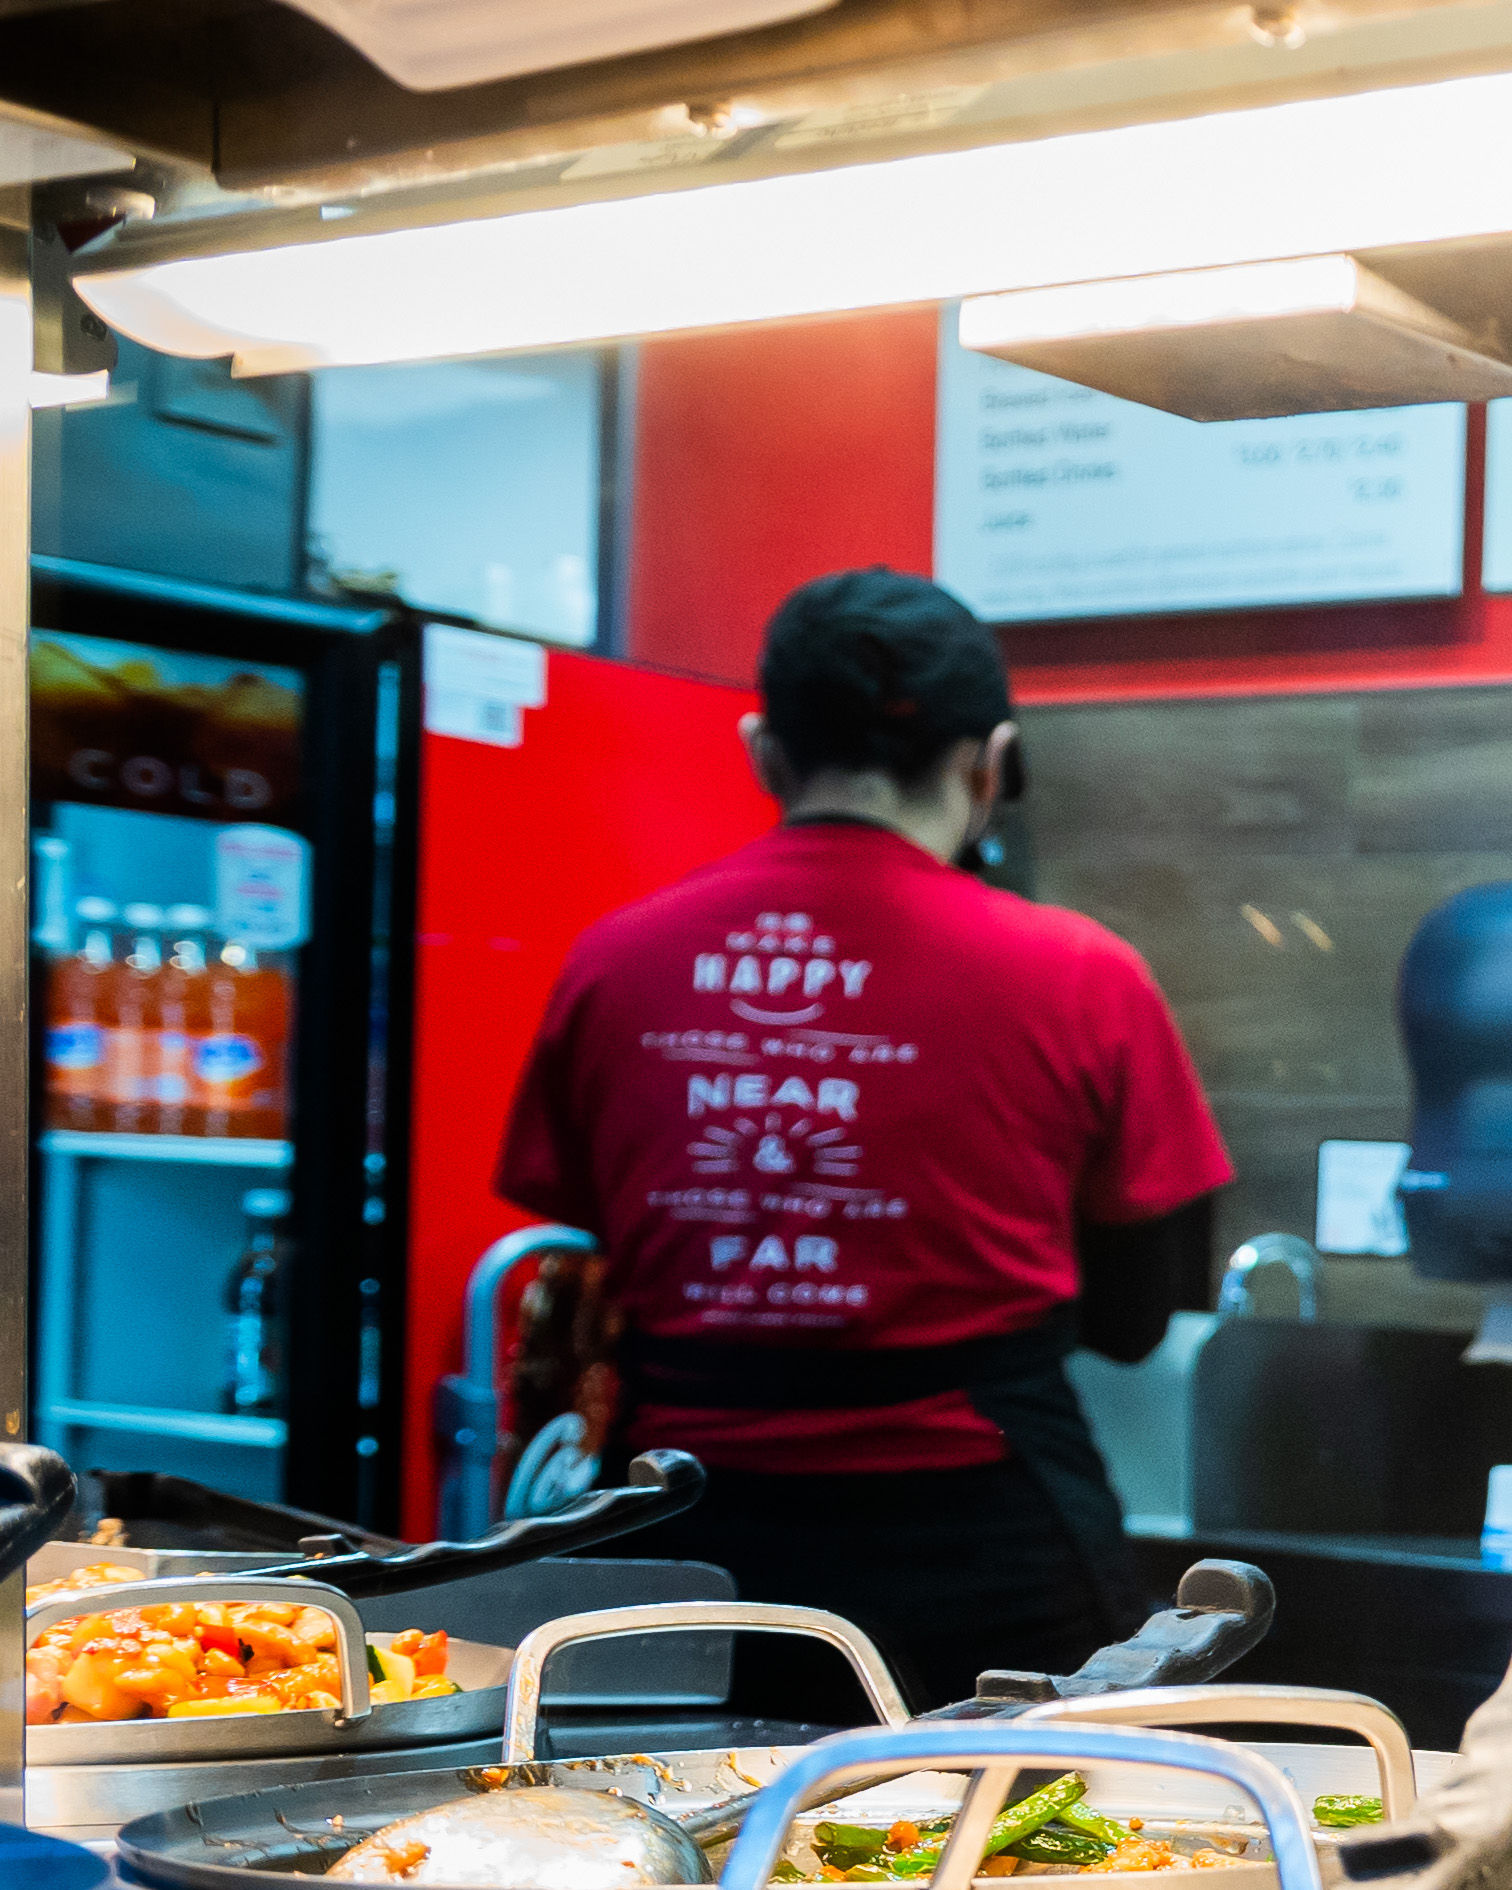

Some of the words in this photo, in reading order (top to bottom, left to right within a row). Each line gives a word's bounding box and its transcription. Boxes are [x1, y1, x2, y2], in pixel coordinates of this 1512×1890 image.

[68, 749, 273, 810] COLD
[692, 952, 874, 999] HAPPY
[686, 1071, 861, 1121] NEAR
[752, 1133, 796, 1174] &
[709, 1233, 839, 1274] FAR
